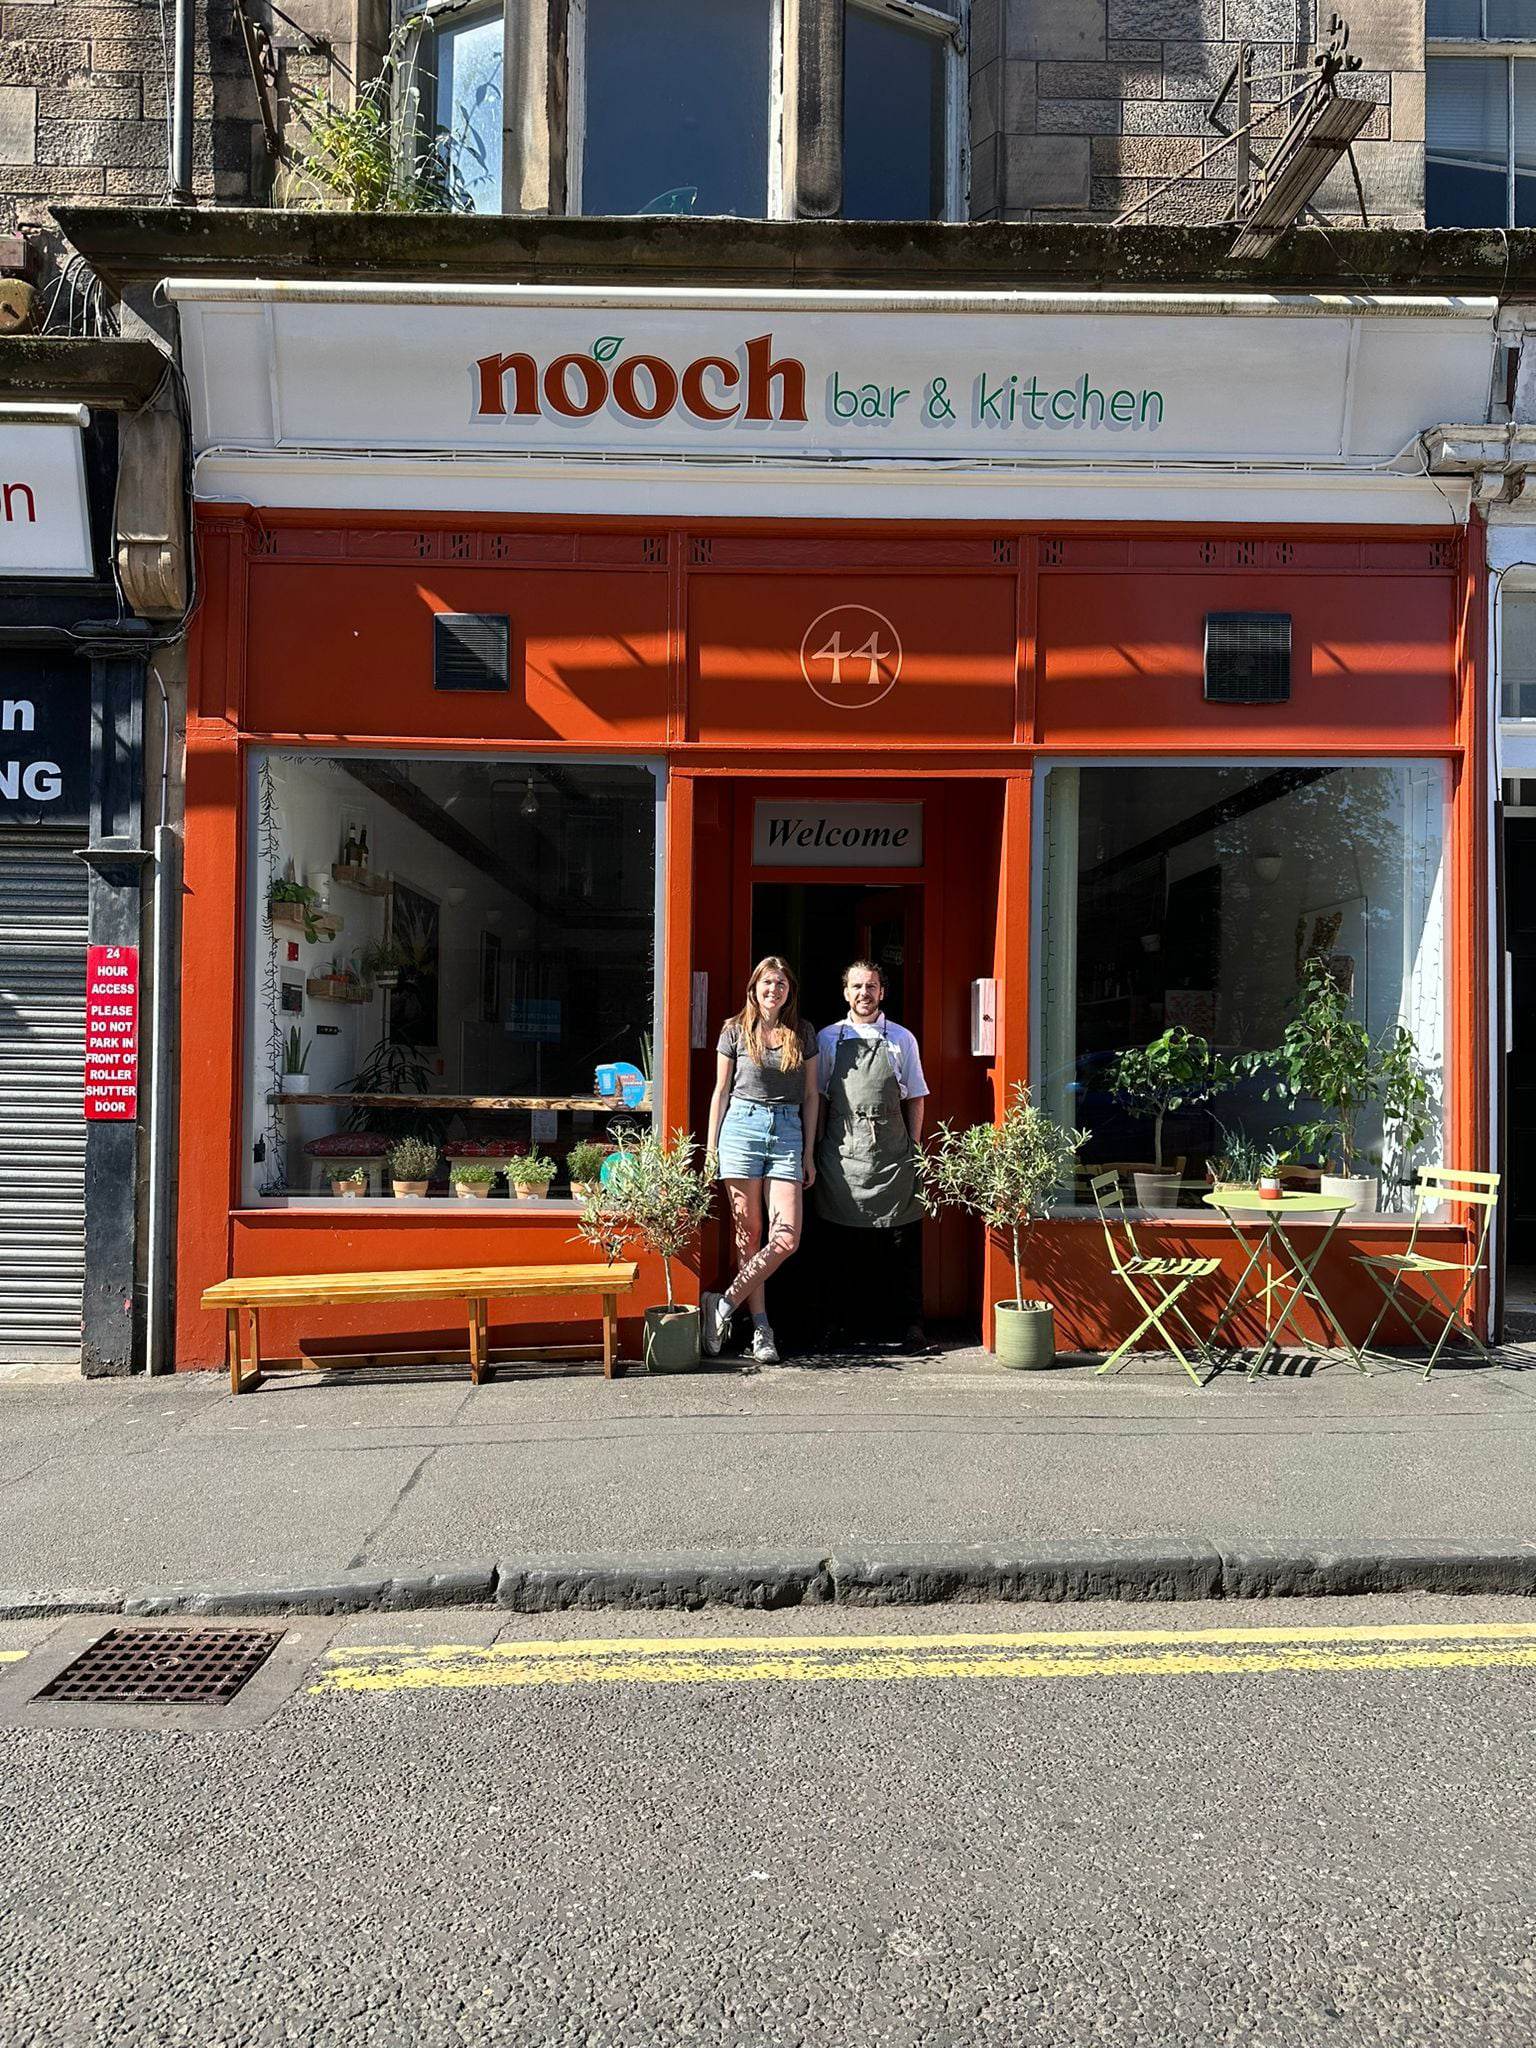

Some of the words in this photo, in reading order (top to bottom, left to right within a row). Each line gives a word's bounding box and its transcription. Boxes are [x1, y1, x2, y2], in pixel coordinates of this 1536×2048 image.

[476, 333, 808, 421] nooch
[832, 371, 911, 419] bar
[928, 376, 956, 420] &
[980, 372, 1164, 423] kitchen
[0, 483, 36, 522] n
[811, 631, 891, 684] 44
[768, 818, 910, 848] Welcome
[106, 948, 120, 959] 24
[97, 965, 129, 977] HOUR
[91, 983, 135, 995] ACCESS
[90, 1005, 133, 1017] PLEASE
[90, 1021, 107, 1033] DO
[109, 1021, 133, 1033] NOT
[89, 1037, 119, 1049] PARK
[122, 1036, 134, 1049] IN
[86, 1053, 121, 1065] FRONT
[122, 1053, 138, 1065] OF
[89, 1069, 132, 1081] ROLLER
[85, 1085, 137, 1097] SHUTTER
[94, 1101, 126, 1113] DOOR
